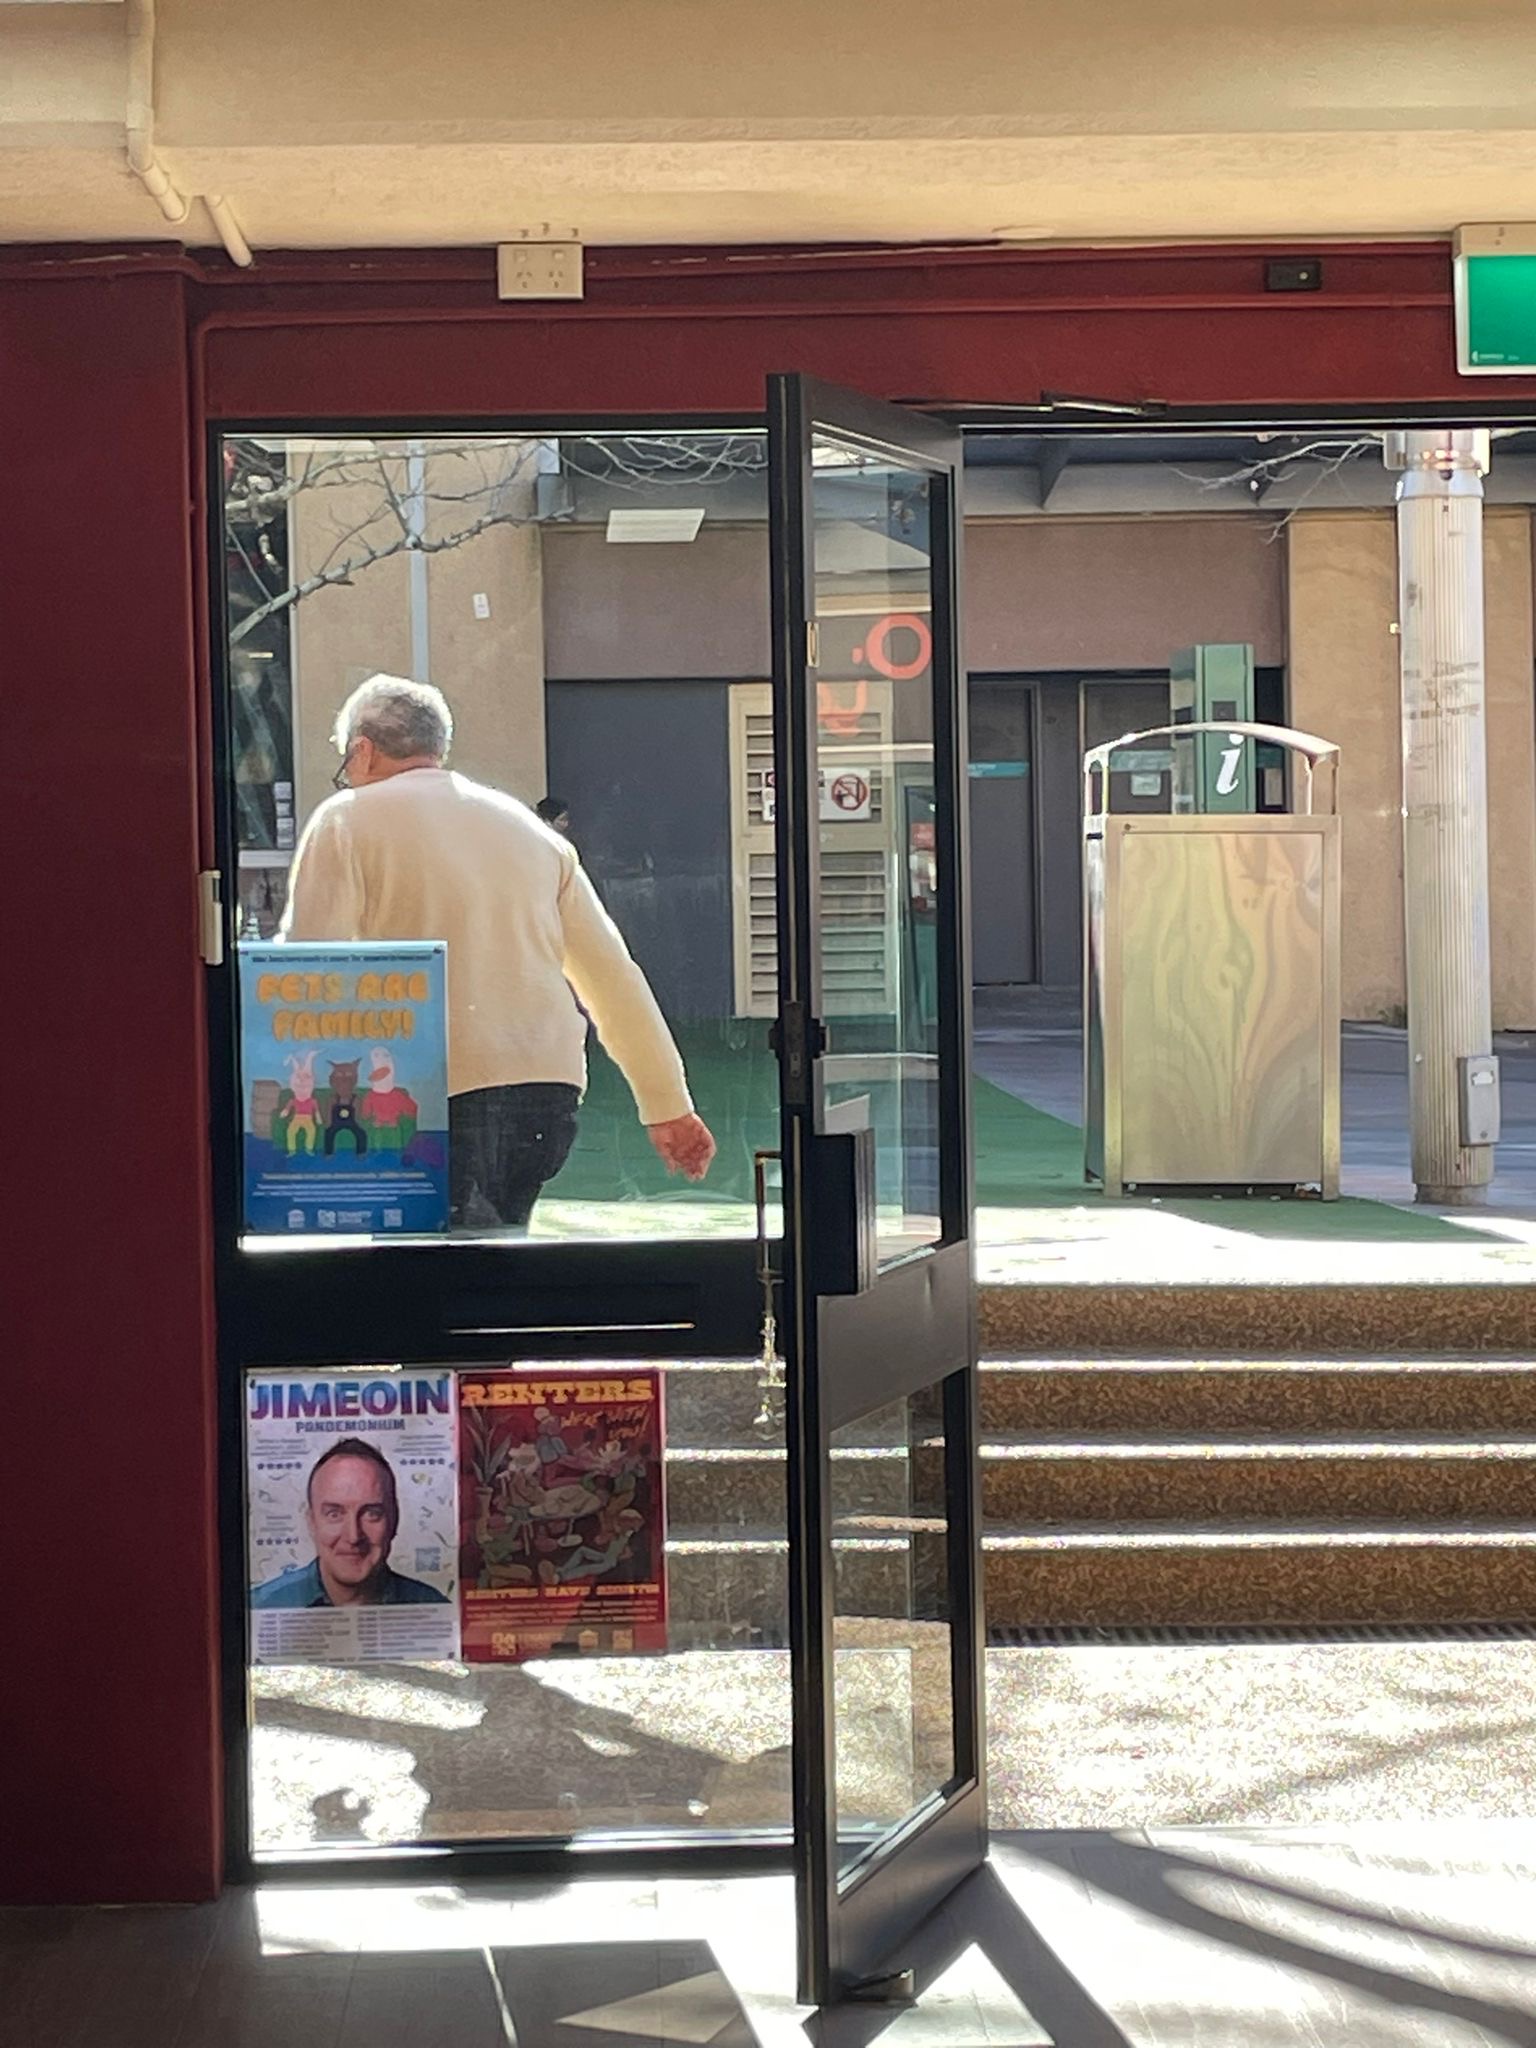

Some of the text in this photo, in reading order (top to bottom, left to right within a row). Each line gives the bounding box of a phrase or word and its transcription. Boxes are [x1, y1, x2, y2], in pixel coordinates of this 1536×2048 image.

[257, 971, 429, 1004] PETS ARE
[273, 1009, 414, 1041] FAMILY!
[251, 1379, 450, 1420] JIMEOIN
[461, 1379, 655, 1407] RENTERS
[296, 1419, 406, 1434] PANDEMONIUM
